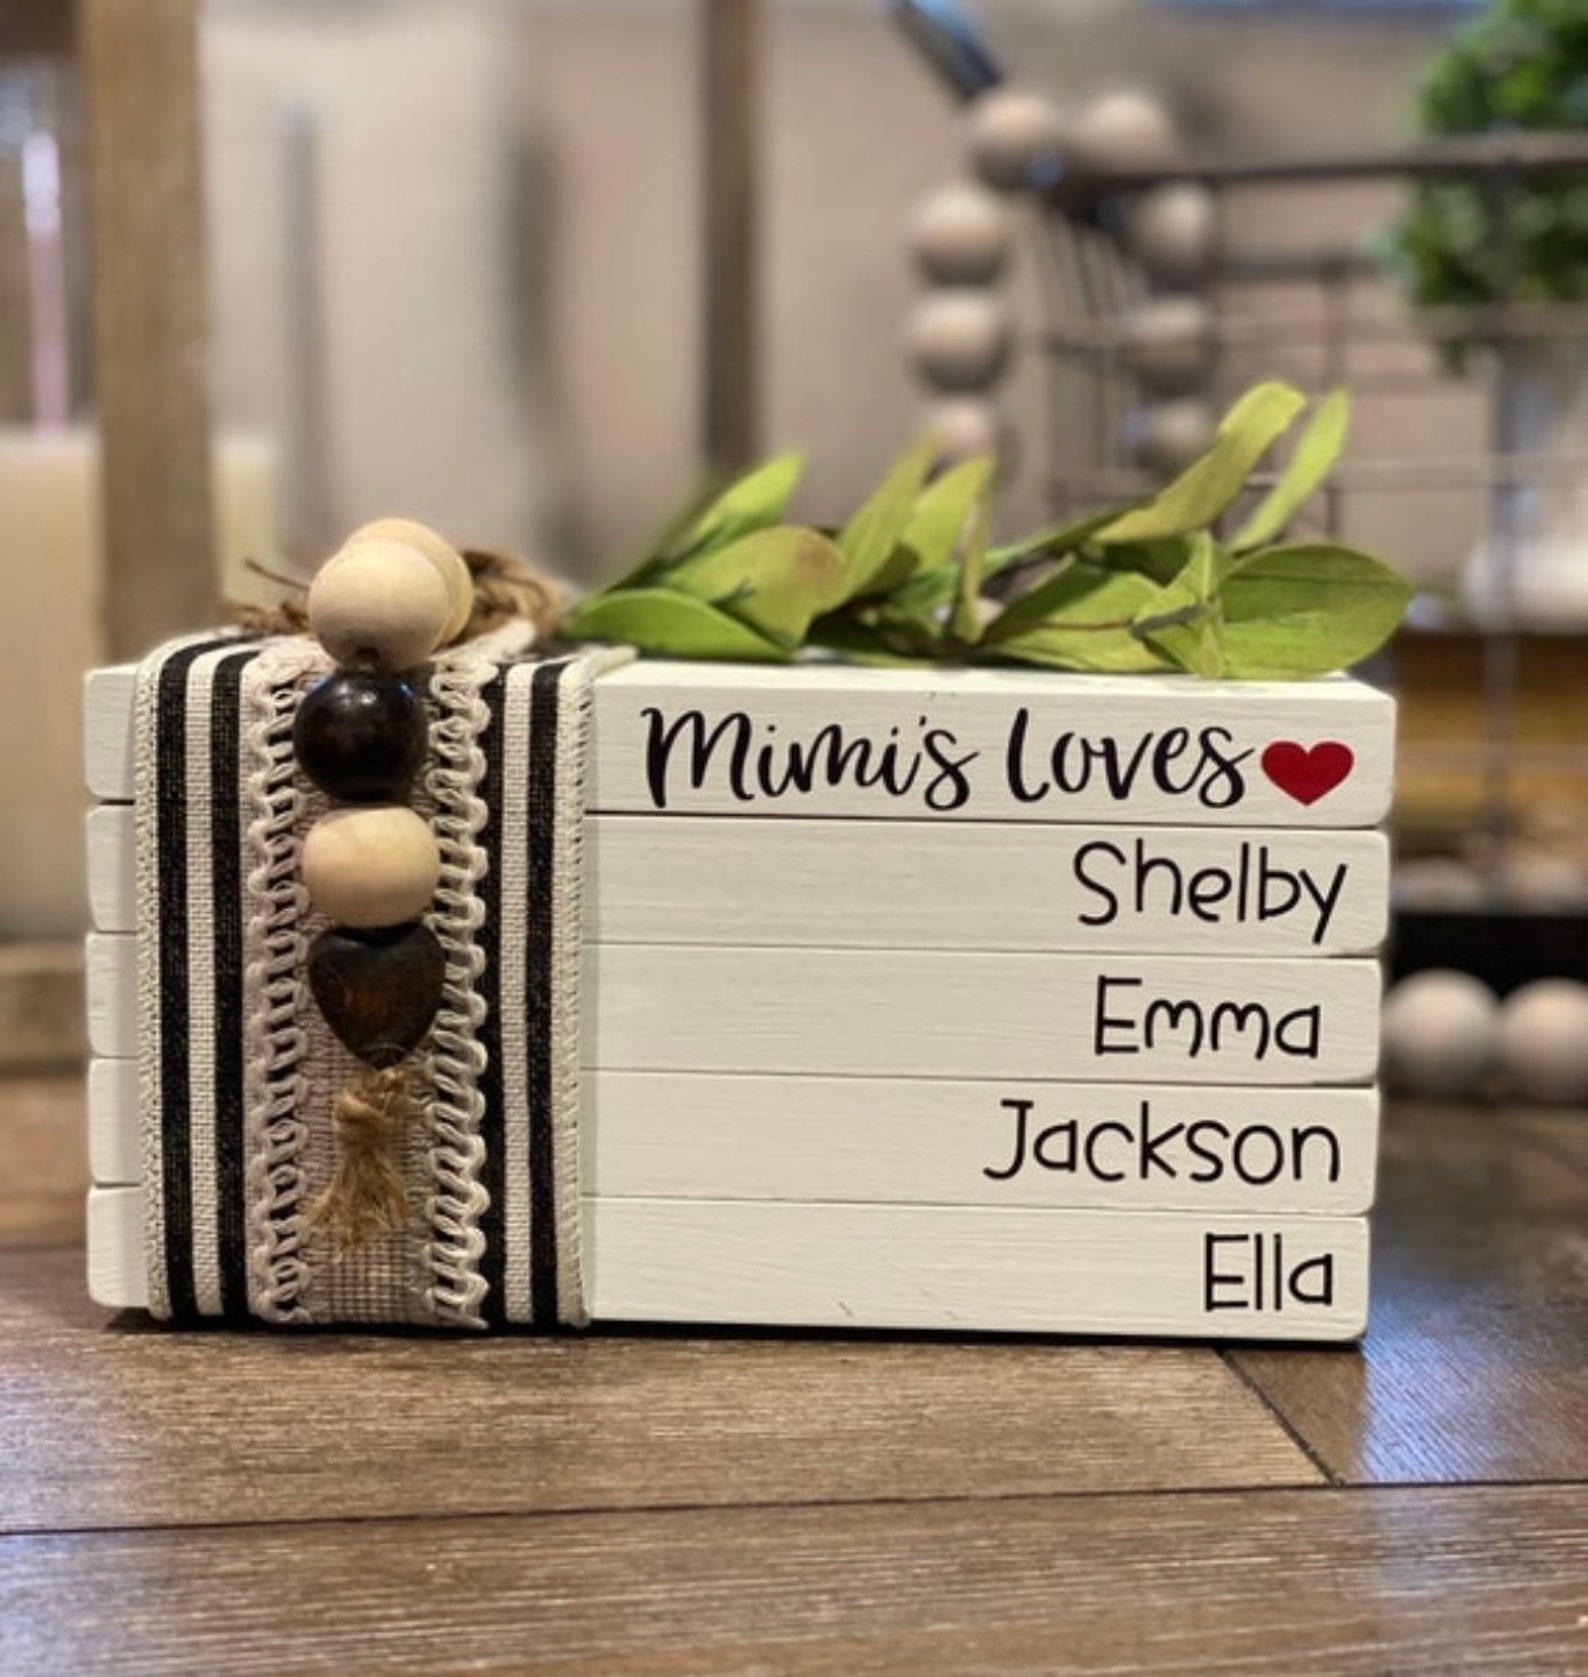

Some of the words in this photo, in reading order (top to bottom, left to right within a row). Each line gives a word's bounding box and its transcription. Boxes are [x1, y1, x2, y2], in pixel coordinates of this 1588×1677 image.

[640, 707, 980, 810] Mimi's
[1073, 837, 1348, 945] Shelby
[1094, 974, 1321, 1061] Emma
[982, 1098, 1340, 1186] Jackson
[1204, 1232, 1333, 1313] Ella
